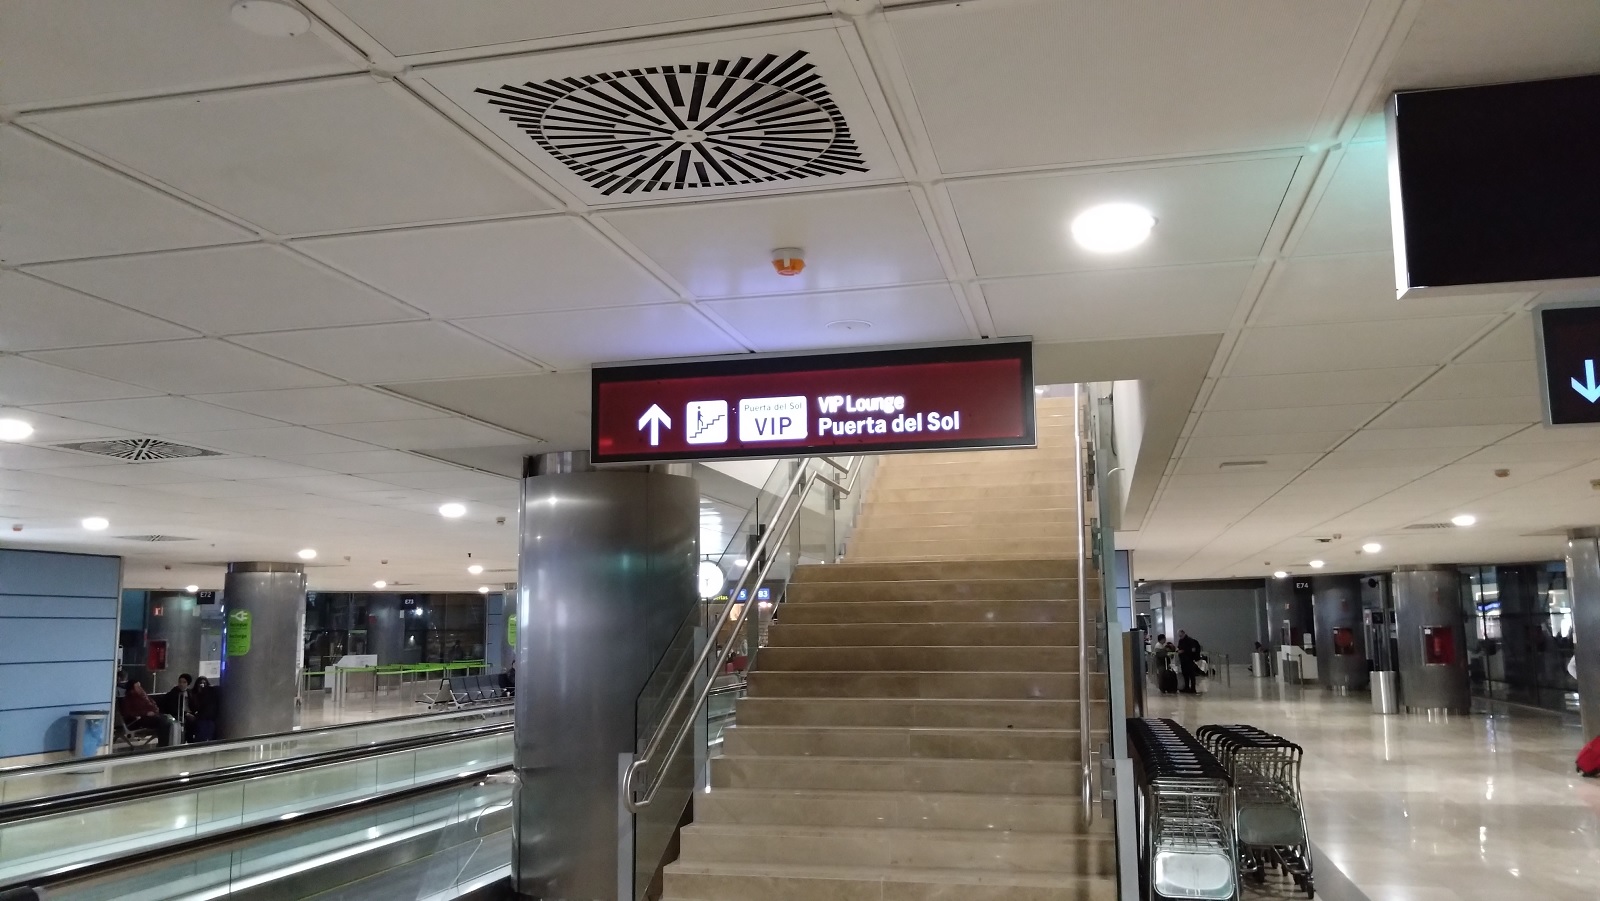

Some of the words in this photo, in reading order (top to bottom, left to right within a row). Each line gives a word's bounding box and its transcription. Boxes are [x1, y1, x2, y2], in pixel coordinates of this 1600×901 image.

[744, 404, 771, 412] Puerta
[774, 402, 787, 411] del
[789, 402, 802, 410] Sol
[818, 394, 845, 414] VIP
[846, 394, 905, 414] Lounge
[754, 416, 792, 436] VIP
[818, 416, 887, 436] Puerta
[891, 413, 922, 433] del
[927, 410, 960, 431] Sol
